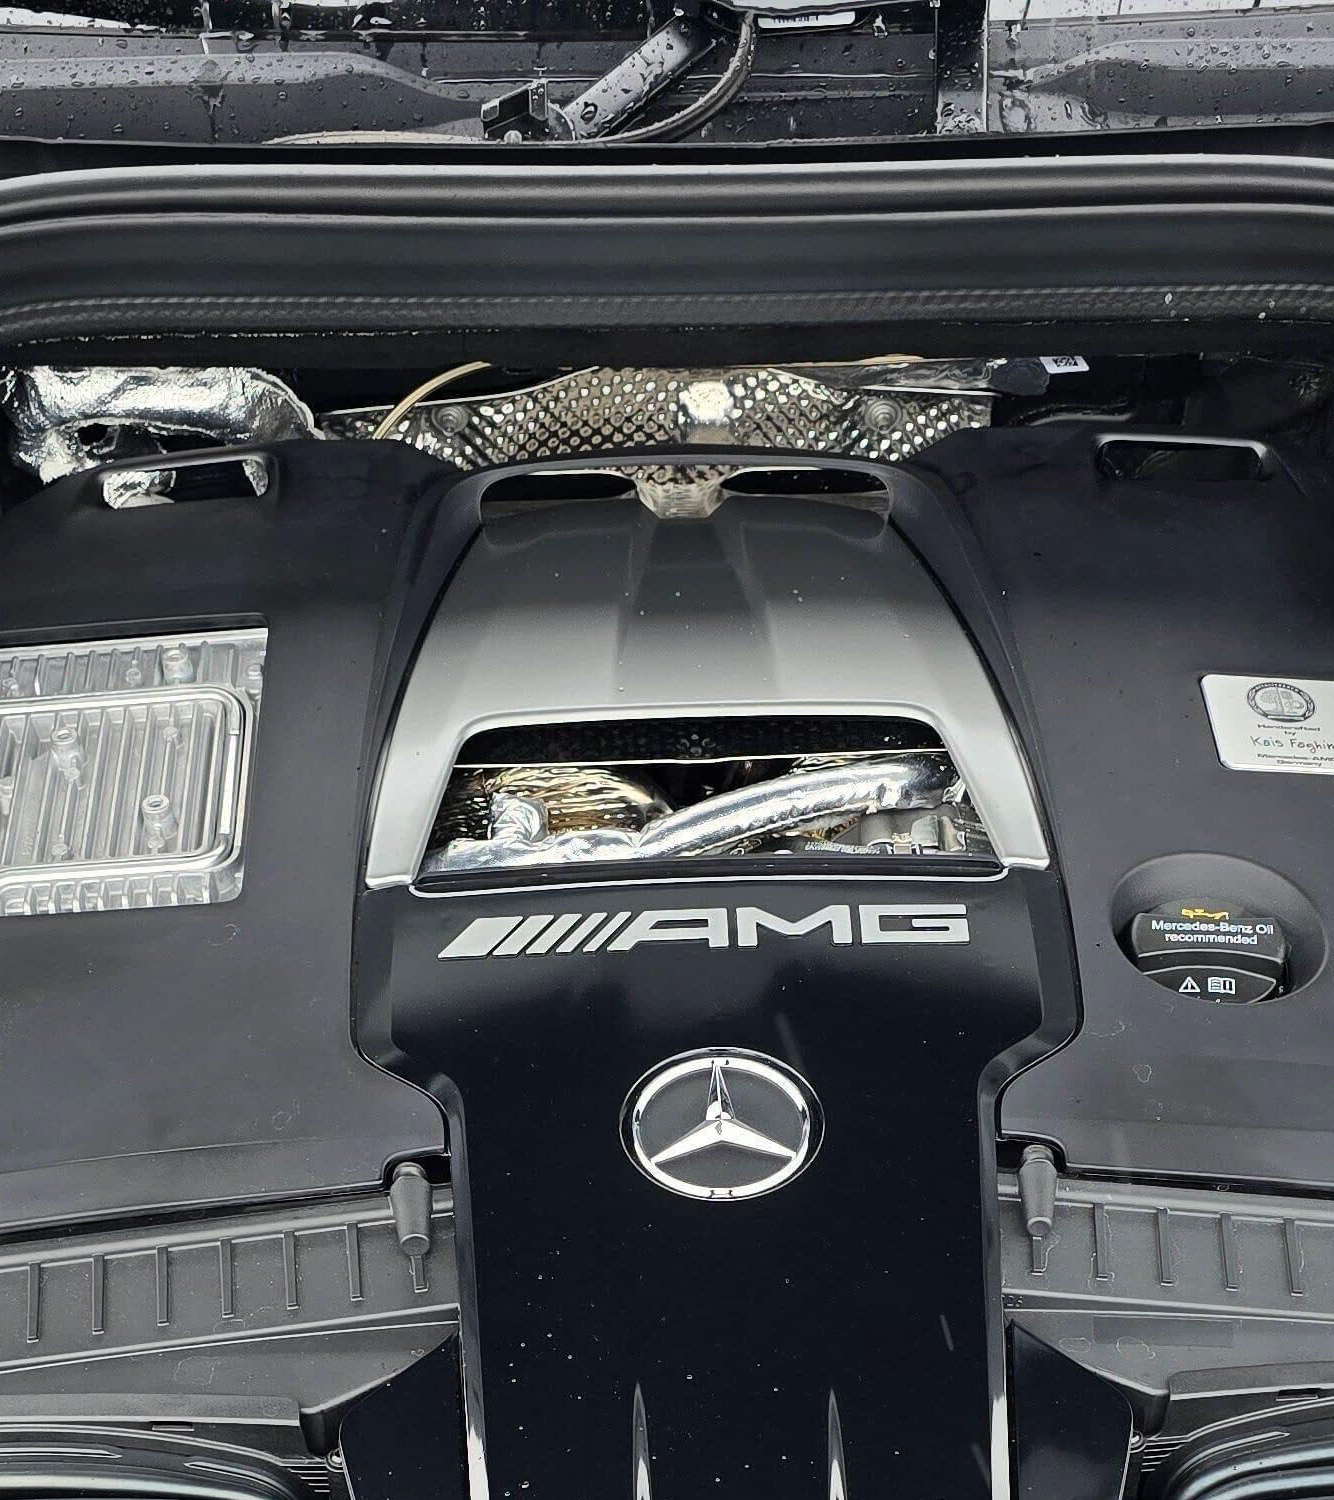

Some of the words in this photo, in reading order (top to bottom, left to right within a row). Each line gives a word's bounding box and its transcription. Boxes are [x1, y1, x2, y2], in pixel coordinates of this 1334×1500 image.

[606, 903, 971, 952] AMG
[1151, 920, 1253, 934] Mercedes-Benz
[1256, 924, 1274, 935] Oil
[1164, 934, 1258, 945] recommended
